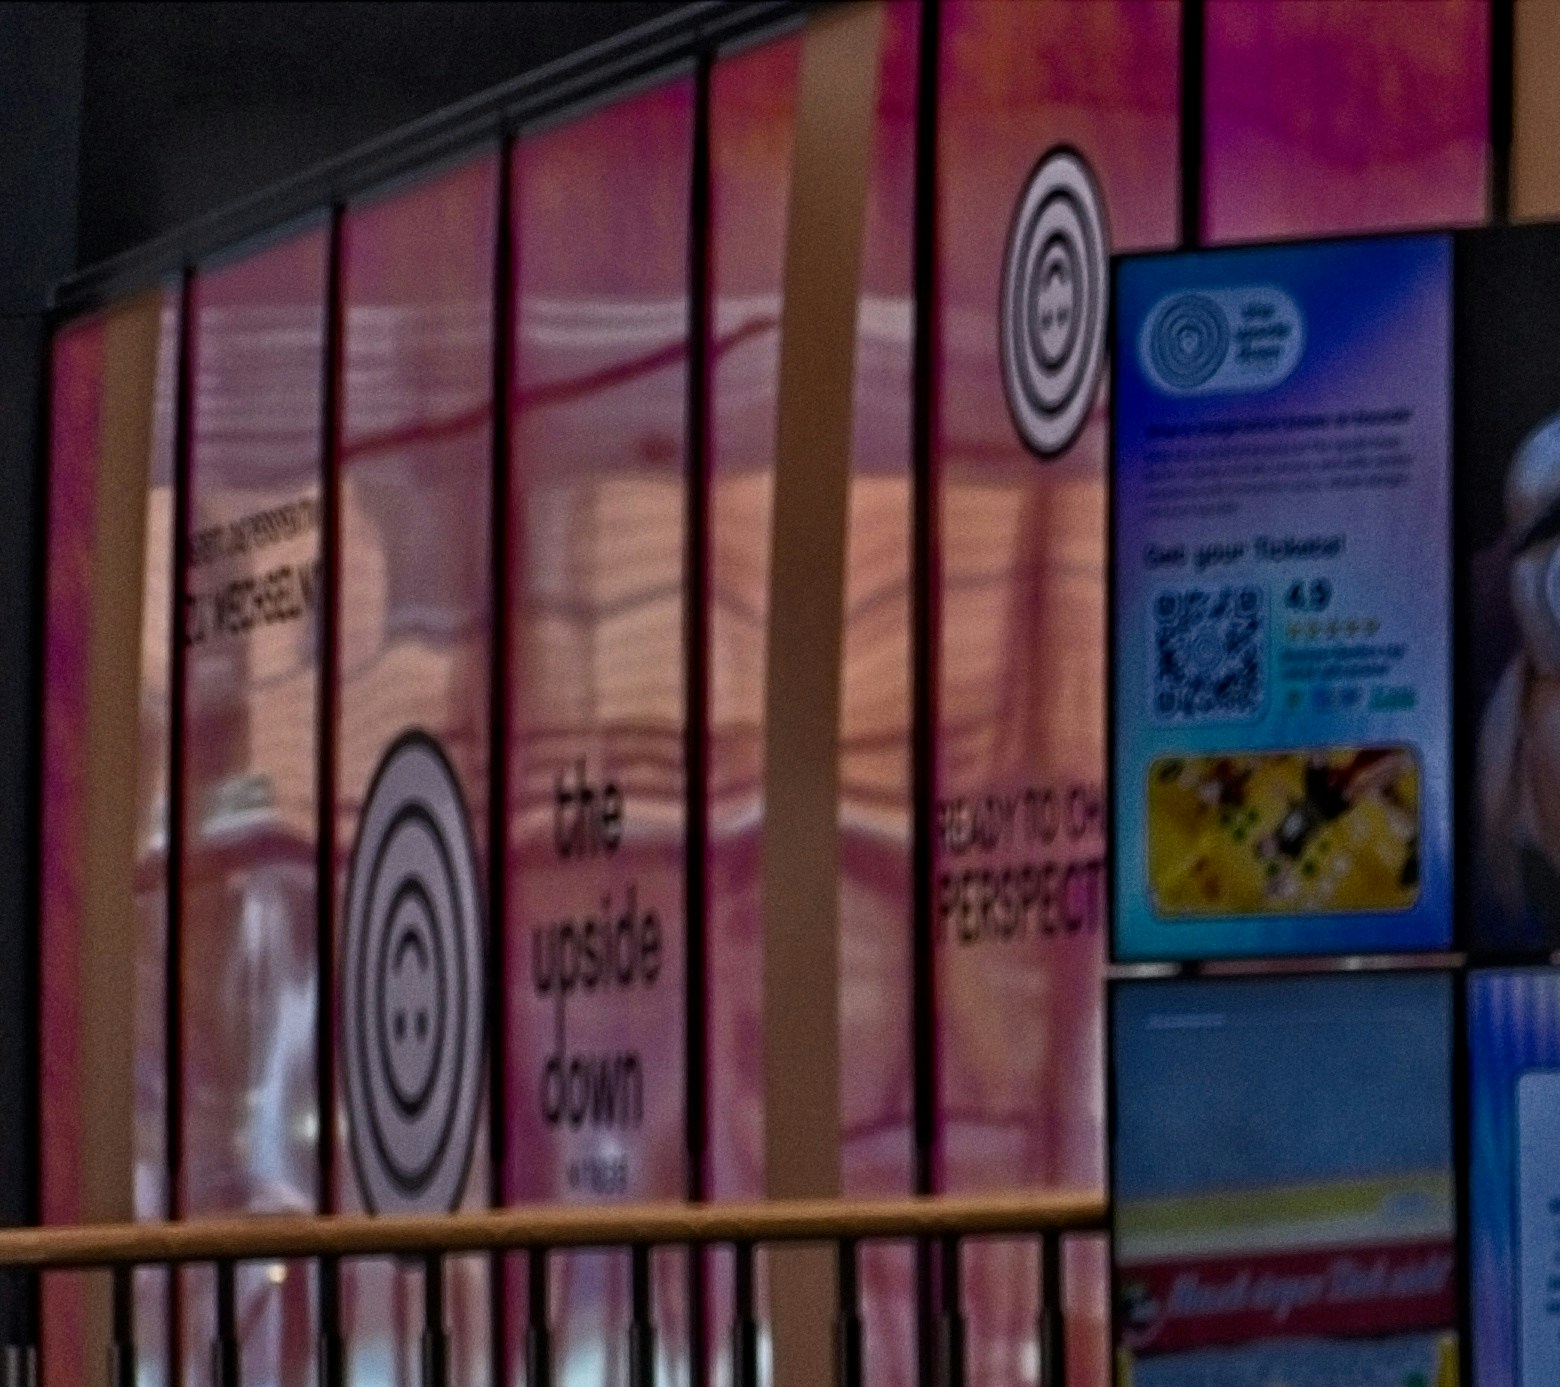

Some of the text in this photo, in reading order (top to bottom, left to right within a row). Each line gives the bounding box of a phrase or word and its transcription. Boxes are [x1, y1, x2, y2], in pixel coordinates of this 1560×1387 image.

[554, 755, 624, 859] the
[531, 883, 662, 1050] upside
[541, 1040, 643, 1131] down
